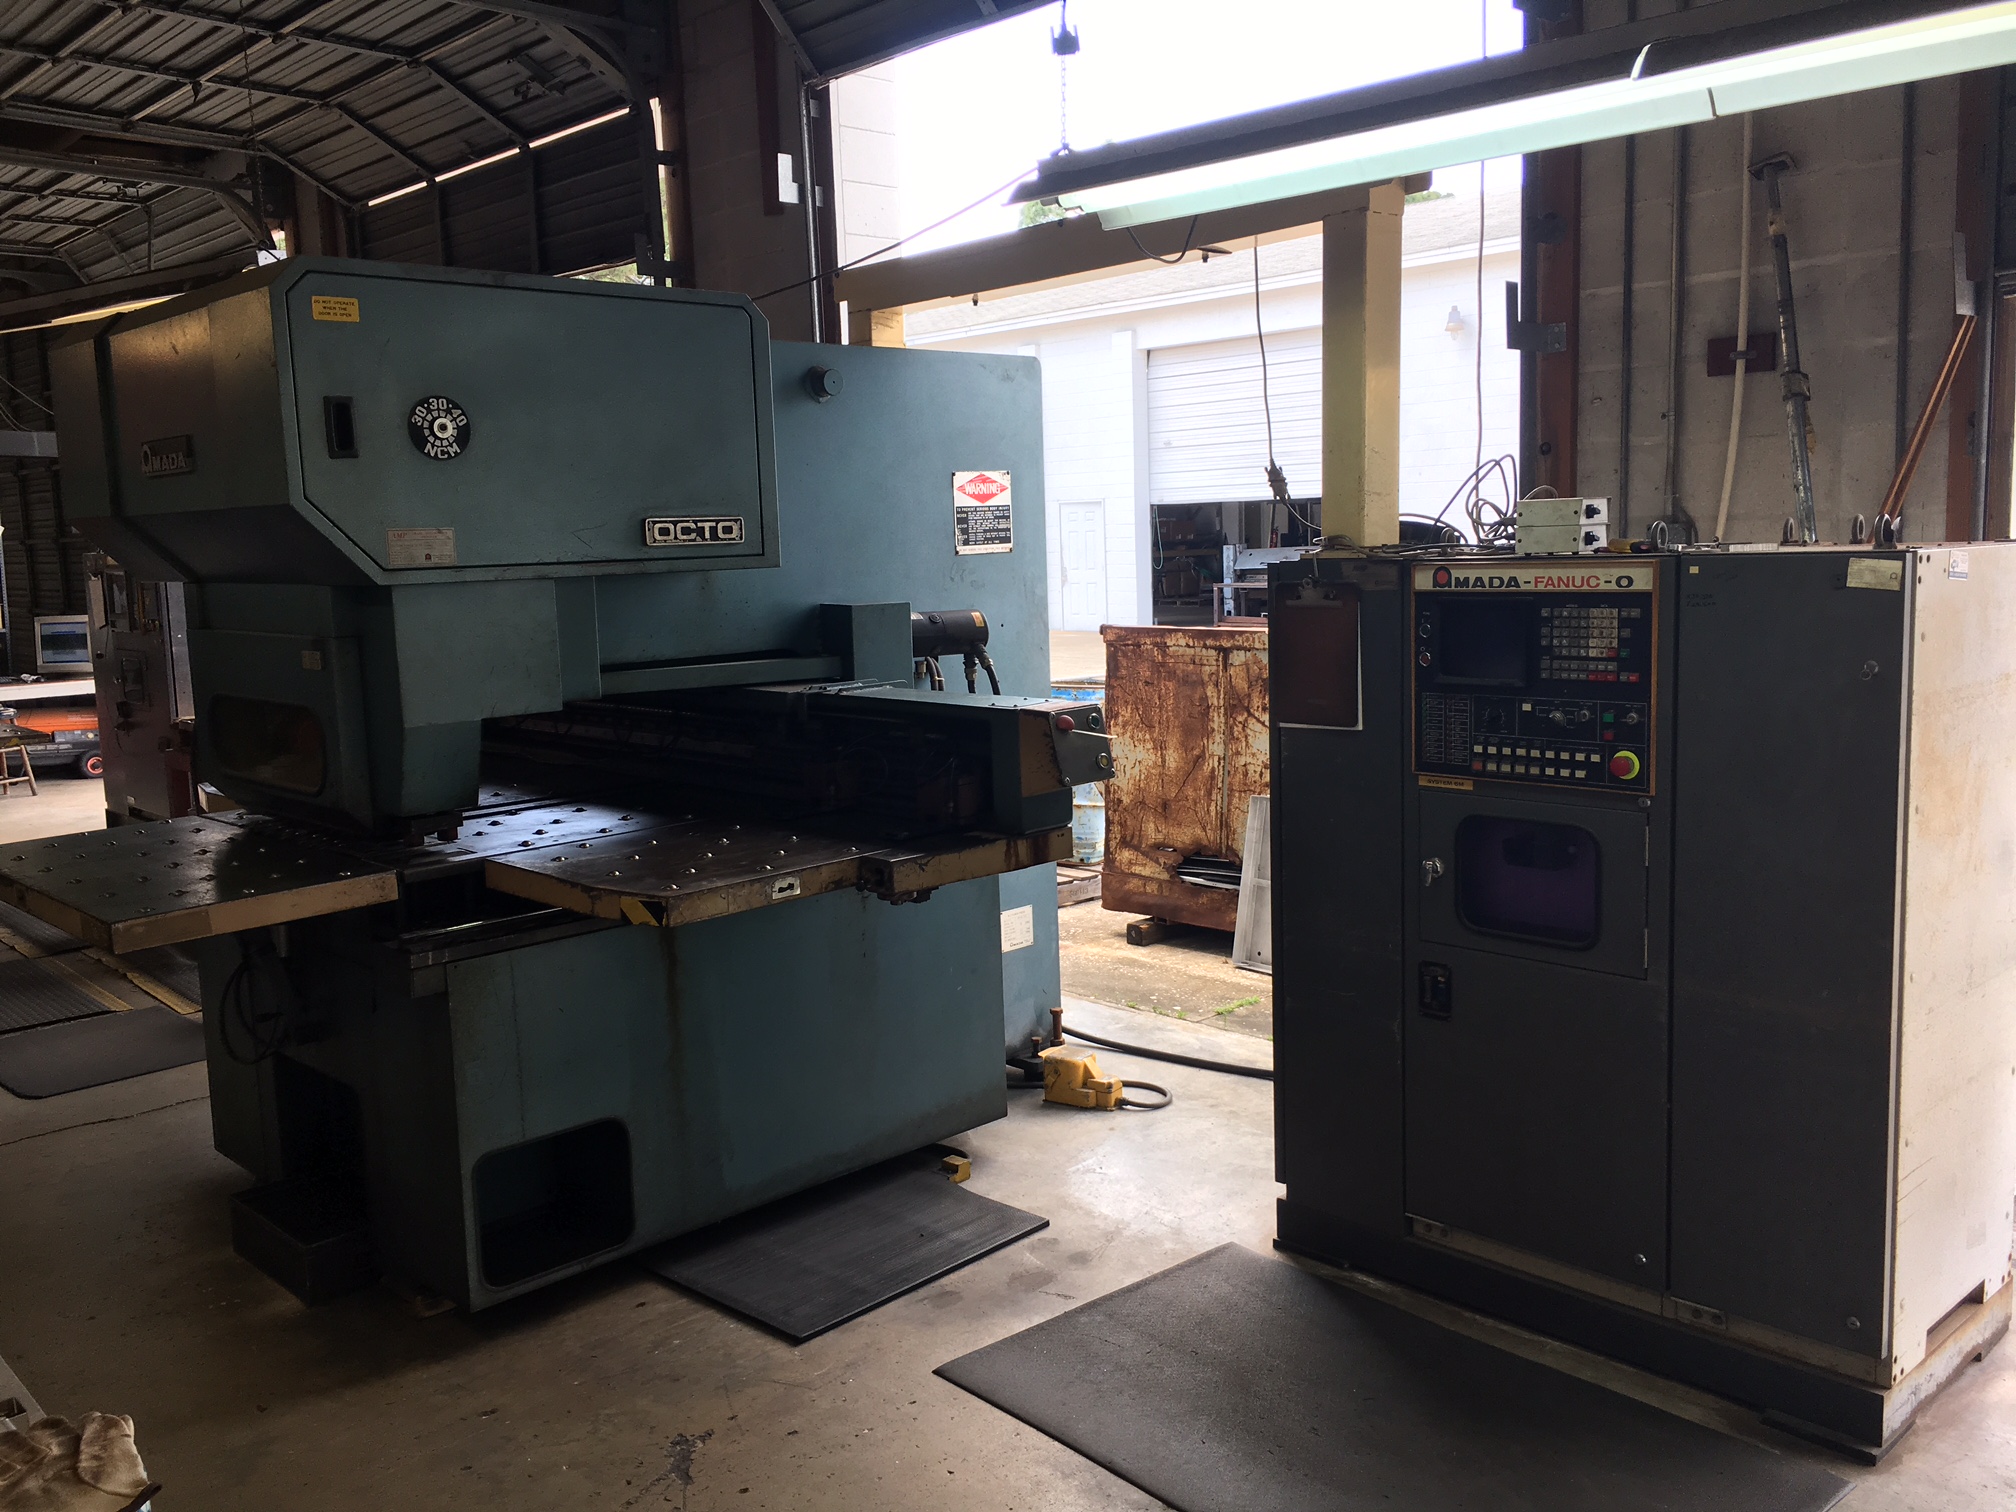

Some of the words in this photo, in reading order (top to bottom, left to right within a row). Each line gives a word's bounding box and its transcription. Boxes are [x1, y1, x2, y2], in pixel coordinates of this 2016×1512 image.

[424, 442, 460, 459] NCM
[965, 482, 1000, 494] WARNING
[653, 521, 738, 540] OCTO
